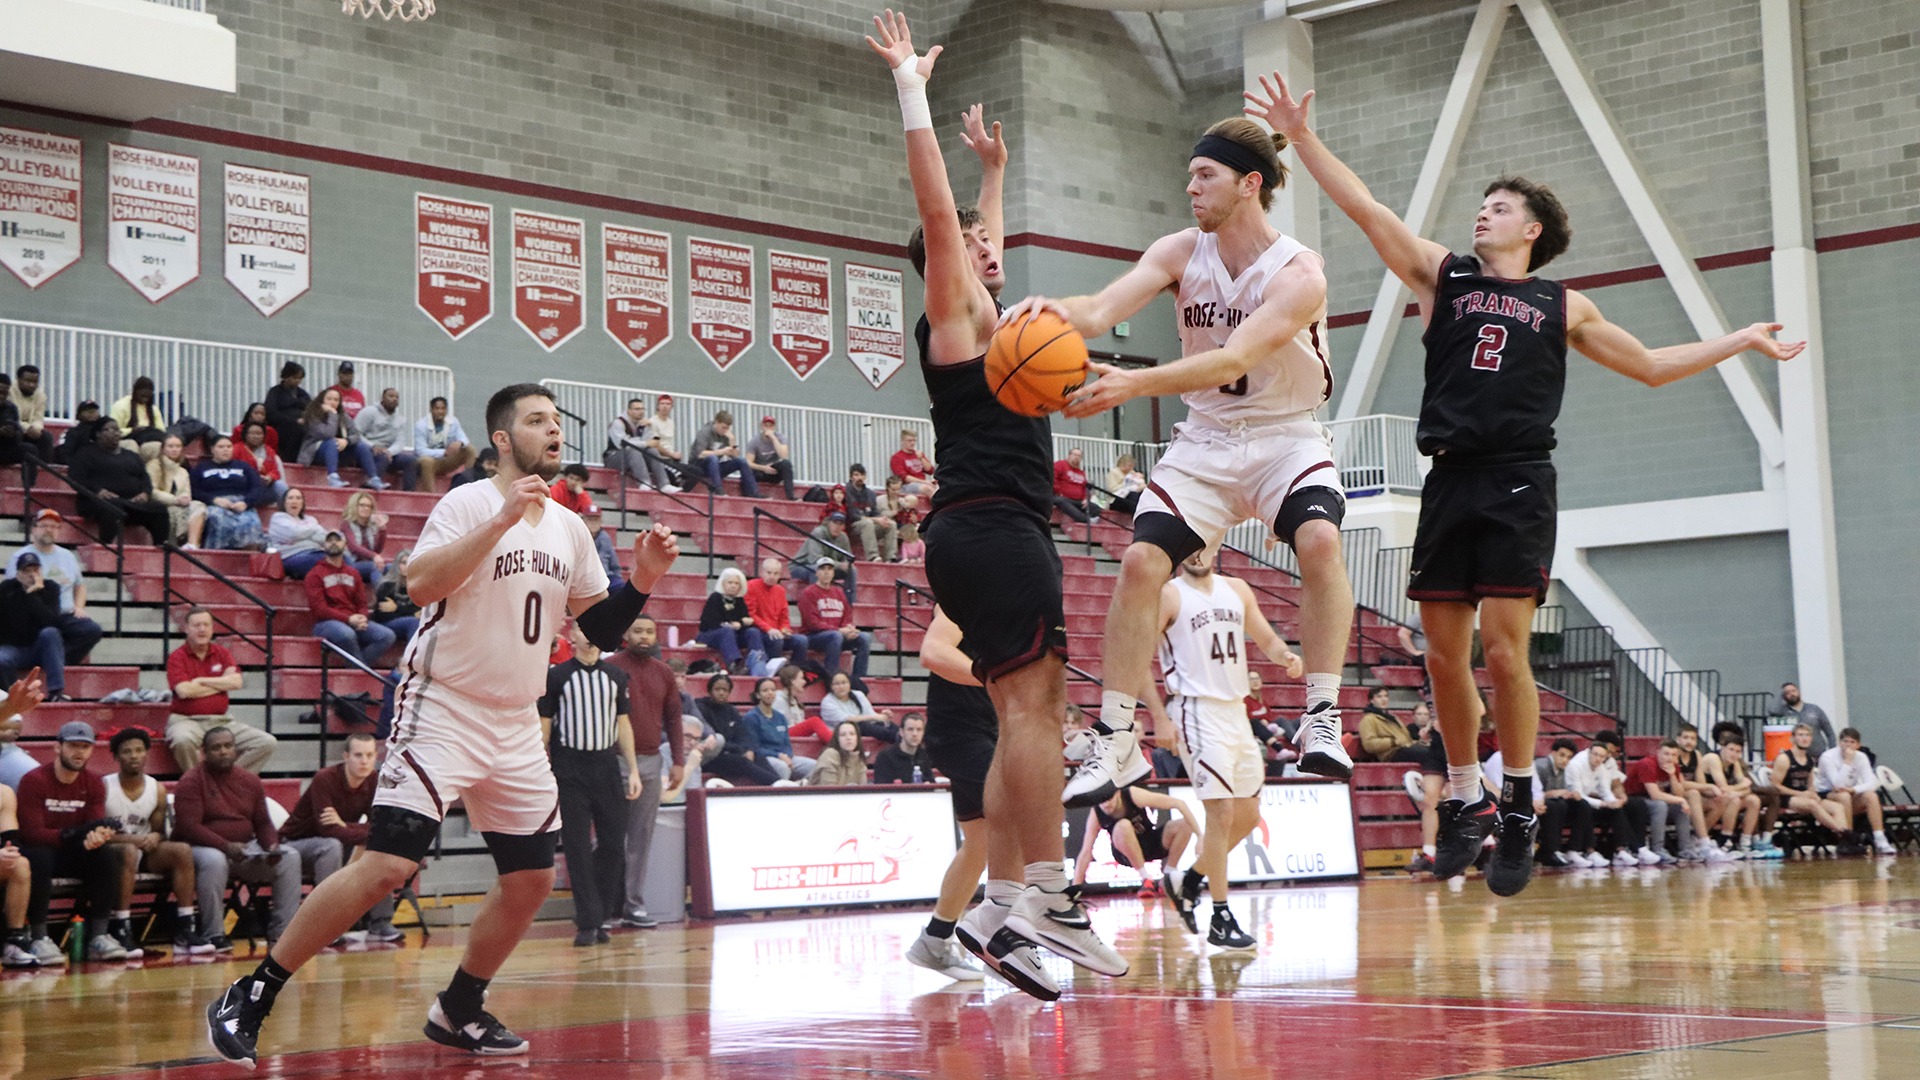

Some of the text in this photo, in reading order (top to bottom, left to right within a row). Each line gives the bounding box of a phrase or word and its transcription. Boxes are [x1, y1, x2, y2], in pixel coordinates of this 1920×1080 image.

[0, 133, 78, 155] OSE-HULMAN
[0, 157, 79, 182] OLLEYBALL
[112, 150, 195, 173] ROSE-HULMAN
[0, 181, 70, 200] OURNAMENT
[112, 175, 195, 198] VOLLEYBALL
[228, 171, 307, 192] ROSE-HULMAN
[0, 193, 77, 219] HAMPIONS
[114, 196, 195, 216] TOURNAMENT
[226, 193, 308, 217] VOLLEYBALL
[420, 200, 488, 220] ROSE-HULMAN
[113, 205, 195, 230] CHAMPIONS
[229, 215, 306, 234] REGULAR SEASON
[516, 216, 580, 234] ROSE-HULMAN
[229, 226, 306, 252] CHAMPIONS
[429, 221, 479, 239] WOMEN'S
[606, 230, 667, 248] ROSE-HULMAN
[420, 232, 488, 252] BASKETBALL
[524, 236, 572, 254] WOMEN'S
[142, 255, 167, 266] 2011
[516, 247, 580, 266] BASKETBALL
[614, 249, 660, 267] WOMEN'S
[692, 244, 750, 262] ROSE-HULMAN
[422, 257, 488, 278] CHAMPIONS
[606, 260, 668, 279] BASKETBALL
[697, 265, 742, 283] WOMEN'S
[772, 256, 828, 274] ROSE-HULMAN
[519, 271, 580, 291] CHAMPIONS
[848, 268, 901, 284] ROSE-HULMAN
[609, 284, 667, 303] CHAMPIONS
[692, 279, 751, 299] BASKETBALL
[777, 277, 821, 295] WOMEN'S
[857, 286, 892, 300] WOMEN'S
[772, 291, 829, 310] BASKETBALL
[852, 297, 898, 313] BASKETBALL
[539, 308, 560, 318] 2017
[694, 307, 749, 326] CHAMPIONS
[858, 309, 893, 329] NCAA
[1452, 290, 1546, 333] TRANSY
[628, 320, 648, 330] 2017
[775, 319, 828, 337] CHAMPIONS
[1470, 323, 1509, 372] 2
[523, 590, 542, 645] 0
[1211, 631, 1238, 665] 44
[1286, 853, 1326, 874] CLUB
[755, 863, 874, 889] ROSE-HULMAN
[806, 889, 871, 901] ATHLETICS
